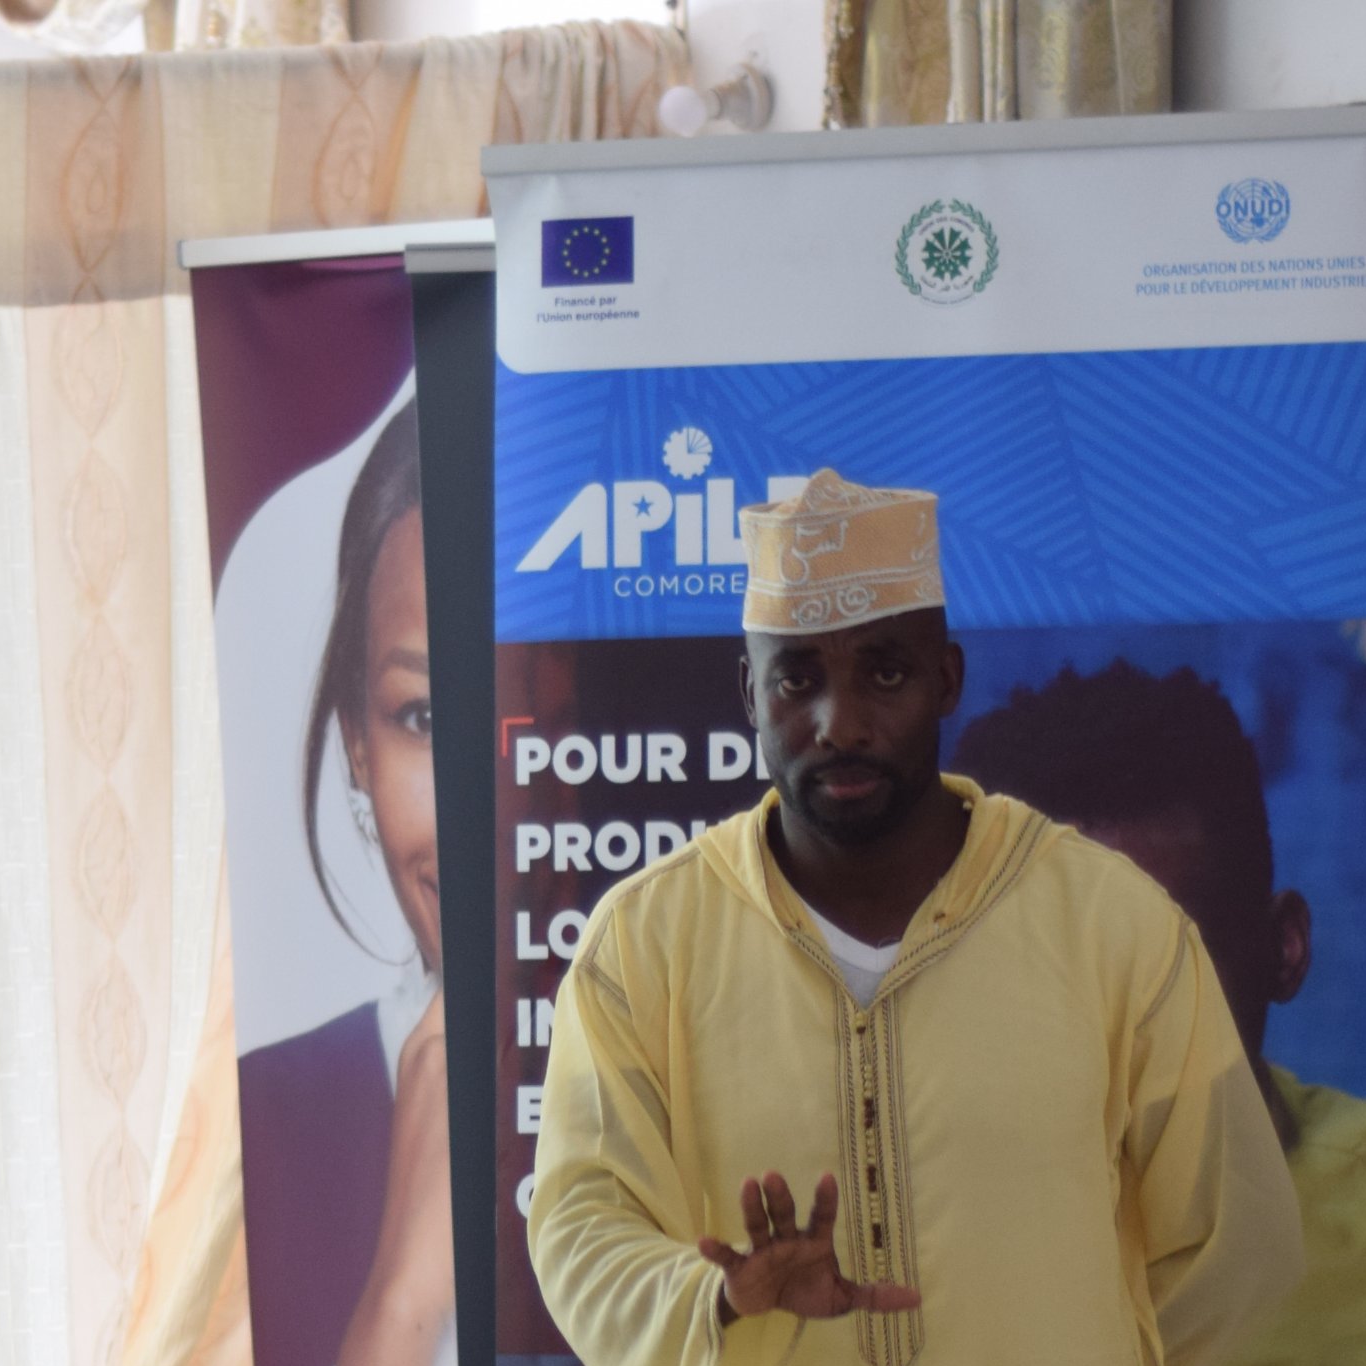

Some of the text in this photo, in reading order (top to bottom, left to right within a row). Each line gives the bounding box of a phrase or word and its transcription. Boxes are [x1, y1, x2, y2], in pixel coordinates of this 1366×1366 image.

[1215, 196, 1291, 218] ONUDI
[1143, 255, 1366, 278] ORGANISATION DES NATIONS UNIES
[1136, 282, 1171, 296] POUR
[1173, 281, 1187, 295] LE
[1191, 277, 1297, 294] DÉVELOPPEMENT
[554, 295, 618, 307] Financé par
[576, 309, 641, 321] européenne
[515, 732, 688, 786] POUR
[515, 819, 727, 873] PROD
